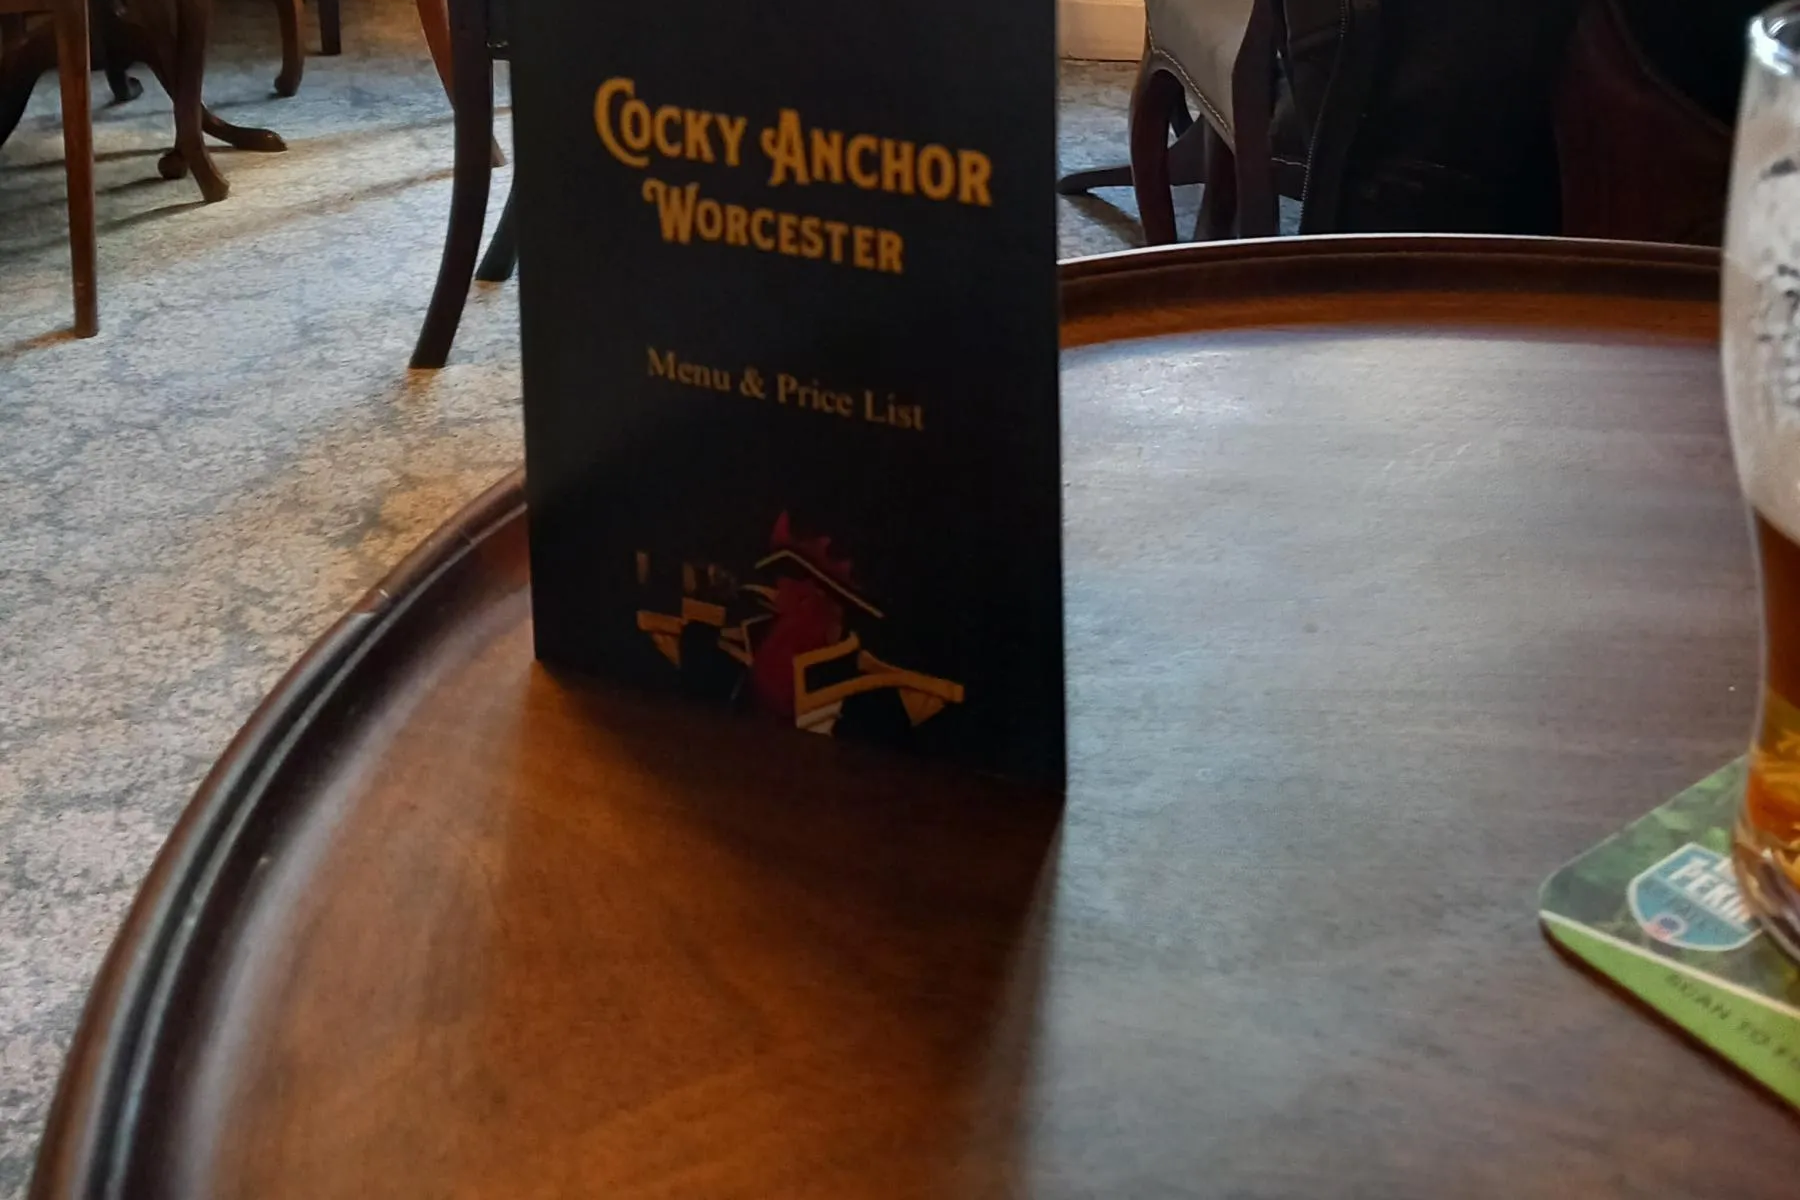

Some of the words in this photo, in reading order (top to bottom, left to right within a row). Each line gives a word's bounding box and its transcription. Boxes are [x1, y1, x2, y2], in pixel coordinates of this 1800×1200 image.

[594, 77, 748, 169] COCKY
[760, 108, 993, 207] ANCHOR
[642, 178, 904, 274] WORCESTER
[646, 347, 733, 393] Menu
[739, 366, 765, 400] &
[776, 371, 854, 418] Price
[863, 390, 925, 432] List
